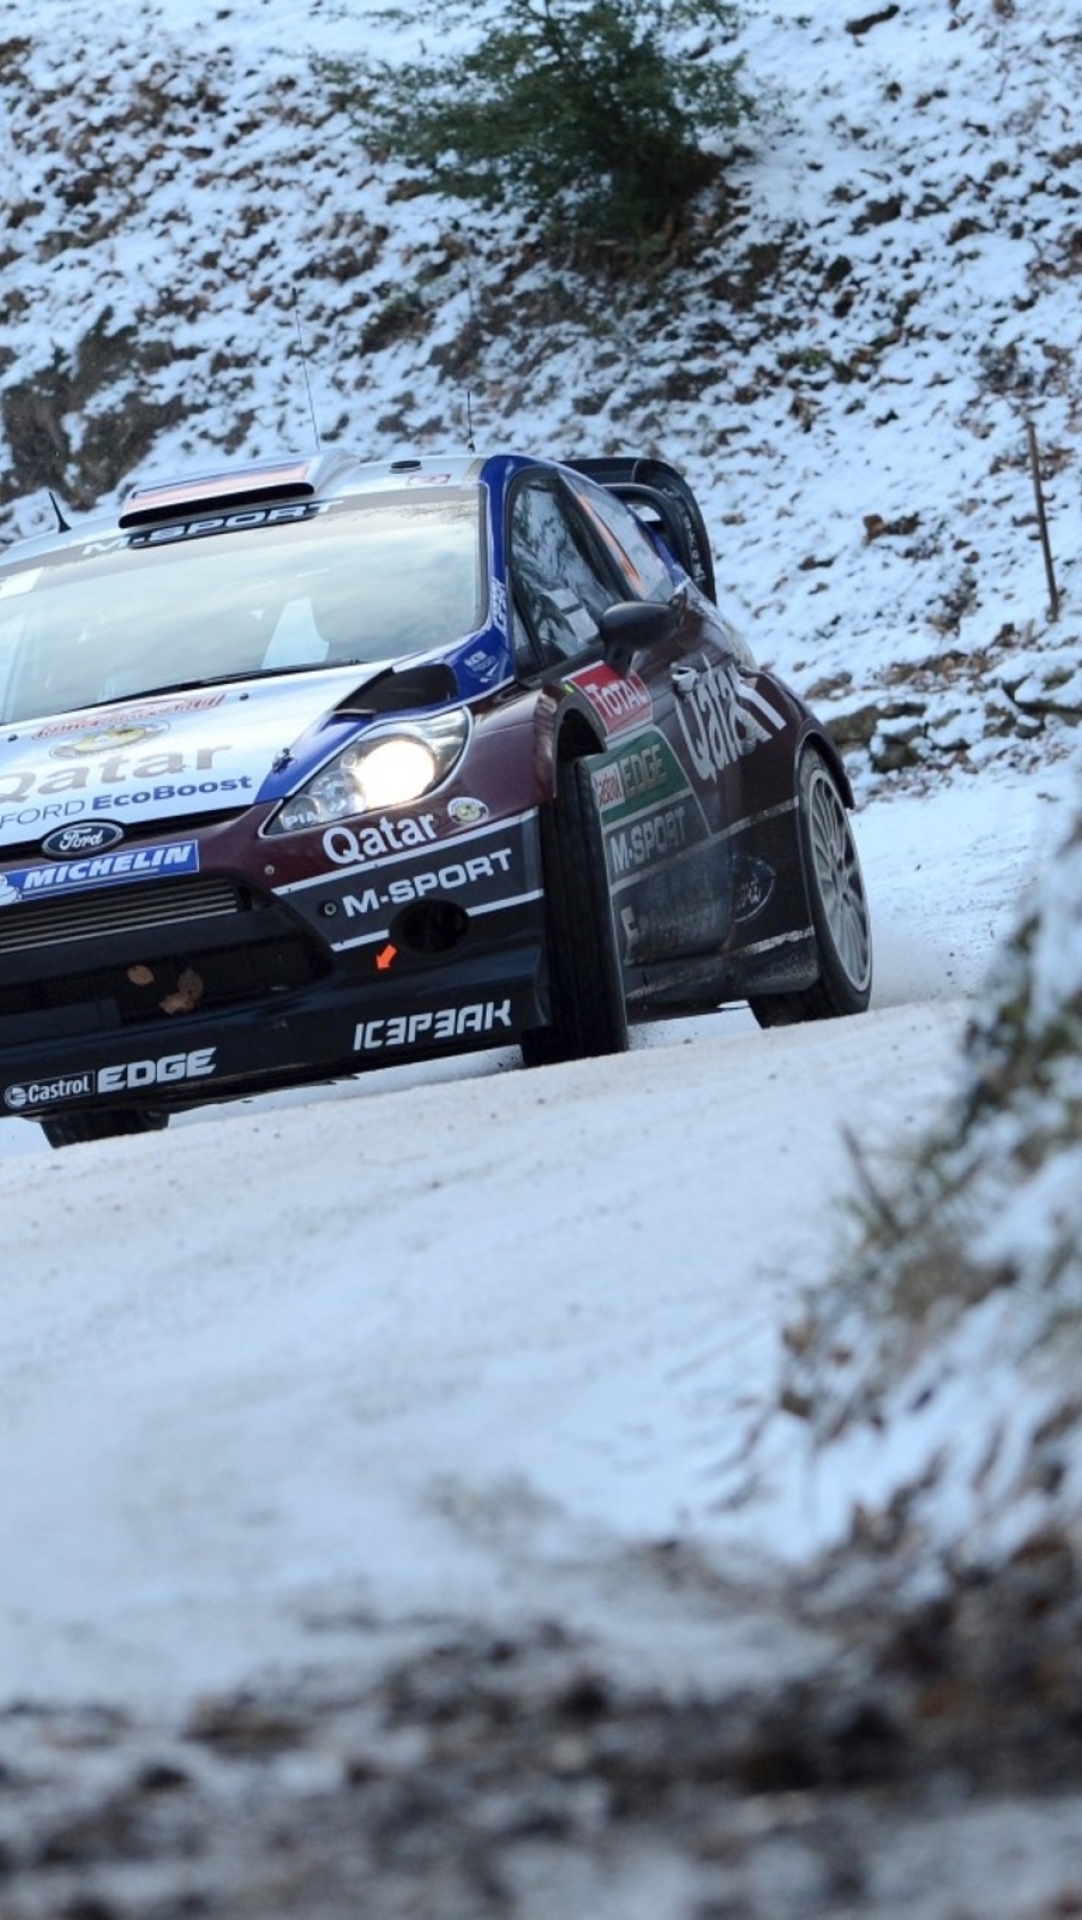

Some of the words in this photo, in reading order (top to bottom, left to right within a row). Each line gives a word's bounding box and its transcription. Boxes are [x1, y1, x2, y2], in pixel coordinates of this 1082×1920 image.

[0, 800, 85, 829] FORD
[92, 776, 253, 811] EcoBoost
[59, 827, 104, 851] Ford
[322, 814, 439, 865] Qatar
[23, 845, 193, 889] MICHELIN
[342, 848, 512, 917] M-SPORT
[28, 1076, 90, 1104] Castrol
[97, 1046, 216, 1094] EDGE
